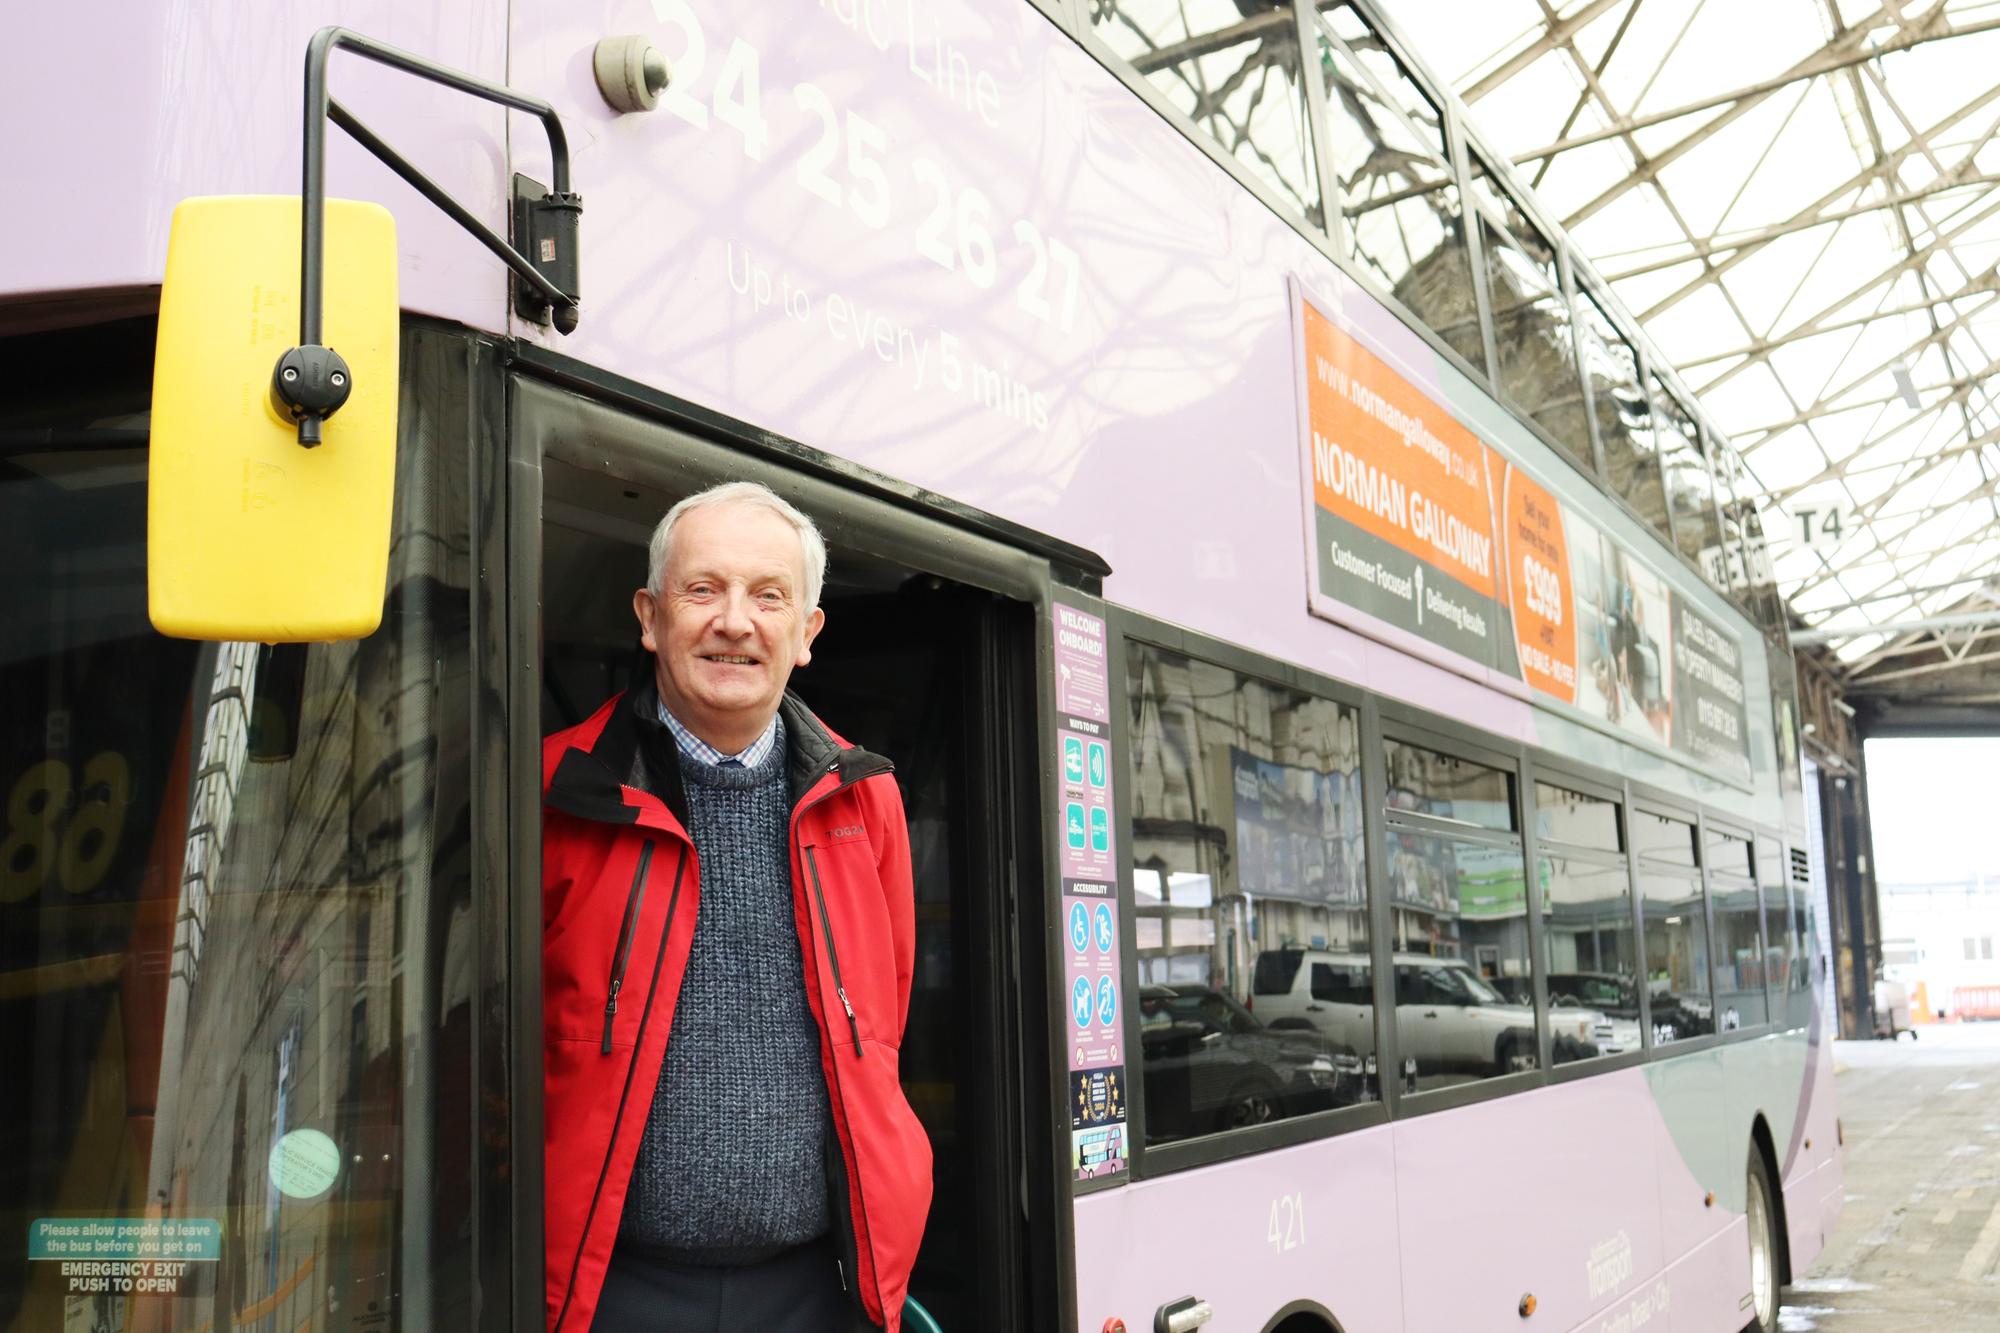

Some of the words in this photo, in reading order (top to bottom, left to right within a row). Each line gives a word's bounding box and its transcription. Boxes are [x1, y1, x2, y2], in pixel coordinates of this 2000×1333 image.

[907, 0, 1000, 128] Line
[793, 83, 890, 229] 25
[913, 159, 997, 289] 26
[1013, 220, 1081, 334] 27
[727, 241, 772, 313] Up
[783, 276, 810, 322] to
[826, 293, 930, 390] every
[939, 330, 963, 393] 5
[973, 362, 1049, 432] mins
[1314, 431, 1407, 529] NORMAN
[1410, 491, 1490, 577] GALLOWAY
[1795, 508, 1843, 543] T4
[1331, 541, 1375, 583] Customer
[1376, 563, 1412, 600] Focused
[1426, 587, 1463, 630] Delivering
[1462, 606, 1486, 637] Results
[1523, 554, 1562, 626] £999
[1059, 608, 1101, 637] WELCOME
[1059, 629, 1103, 658] ONBOARD!
[1069, 718, 1083, 730] WAYS
[1083, 721, 1090, 731] TO
[1090, 723, 1099, 734] PAY
[1073, 882, 1107, 895] ACCESSIBILITY
[40, 1224, 80, 1236] Please
[82, 1224, 116, 1236] allow
[118, 1224, 159, 1238] people
[162, 1225, 174, 1236] to
[177, 1224, 211, 1236] leave
[1267, 1191, 1305, 1254] 421
[47, 1240, 67, 1252] the
[69, 1240, 92, 1252] bus
[95, 1240, 134, 1252] before
[137, 1242, 160, 1254] you
[162, 1242, 183, 1254] get
[186, 1242, 202, 1252] on
[61, 1263, 150, 1276] EMERGENCY
[153, 1263, 186, 1276] EXIT
[69, 1278, 109, 1291] PUSH
[113, 1279, 132, 1292] TO
[136, 1279, 177, 1292] OPEN
